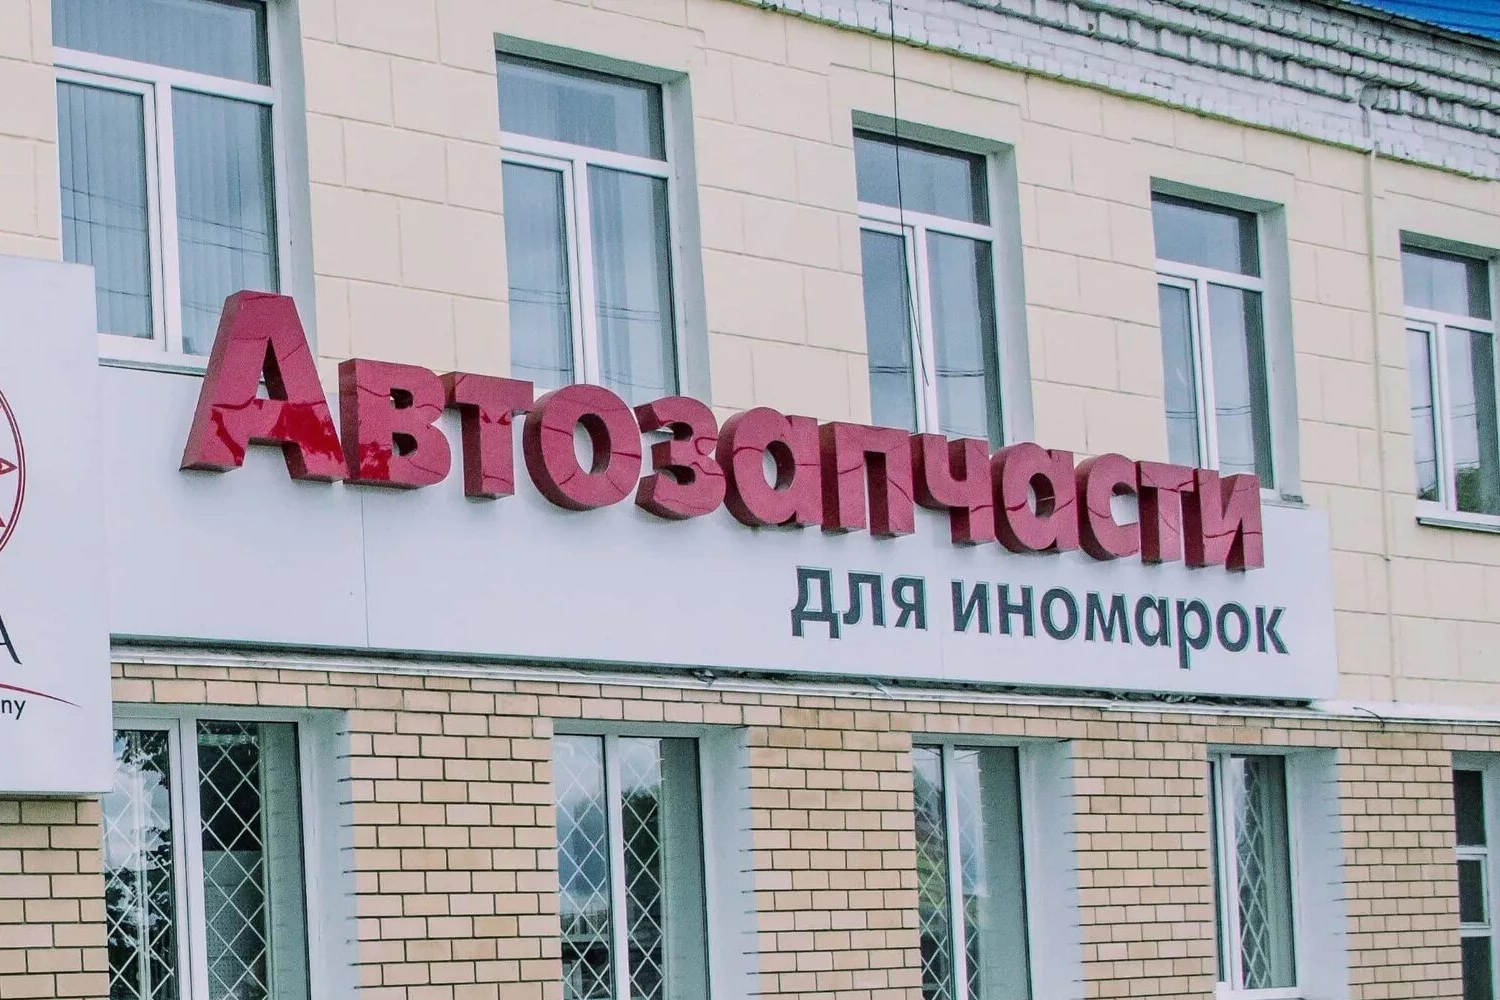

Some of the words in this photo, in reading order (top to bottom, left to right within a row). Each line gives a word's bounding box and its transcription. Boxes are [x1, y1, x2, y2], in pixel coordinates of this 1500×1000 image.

[179, 289, 1264, 571] Автозапчасти
[790, 565, 929, 640] для
[950, 579, 1290, 670] иномарок
